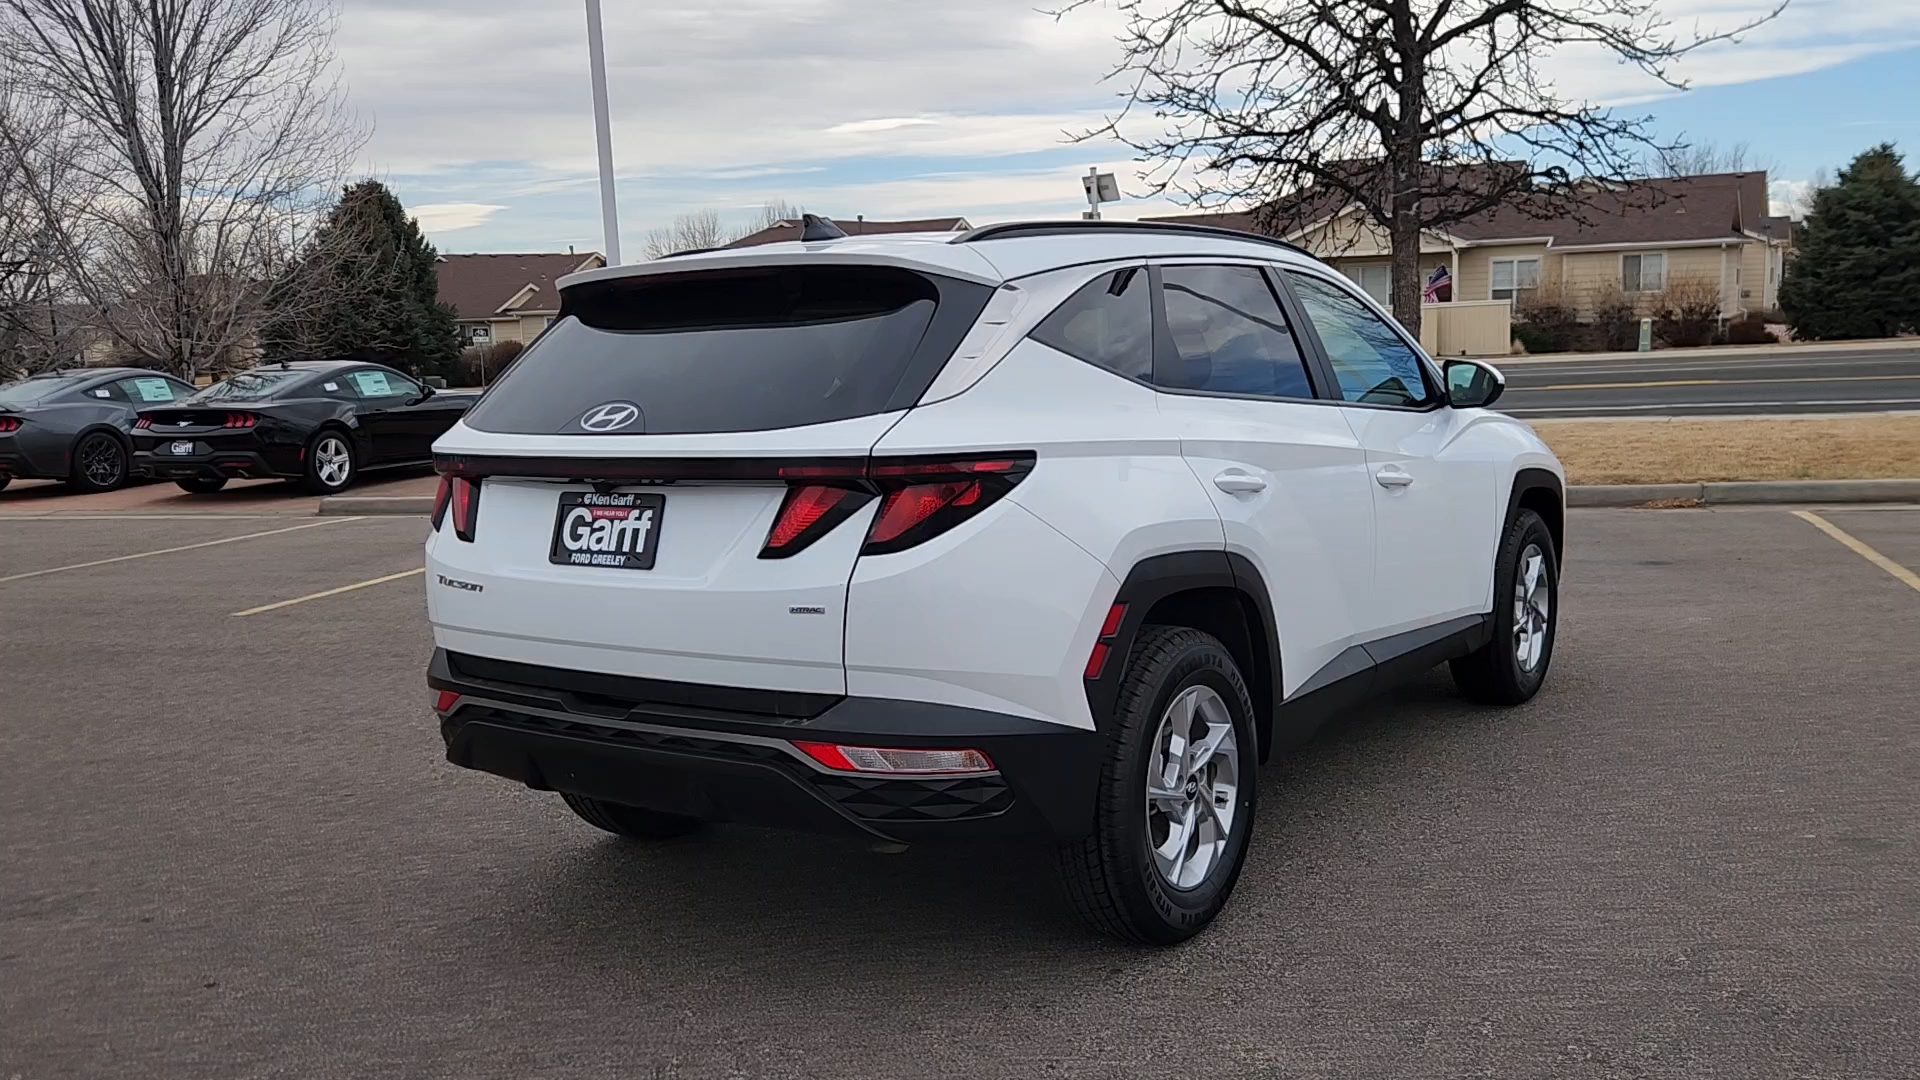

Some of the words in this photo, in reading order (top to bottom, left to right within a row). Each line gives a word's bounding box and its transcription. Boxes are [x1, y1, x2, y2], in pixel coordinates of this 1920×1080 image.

[591, 493, 610, 505] Ken
[610, 494, 635, 506] Garff
[563, 507, 654, 553] Garff
[570, 553, 591, 564] FORD
[591, 554, 626, 566] GREELEY
